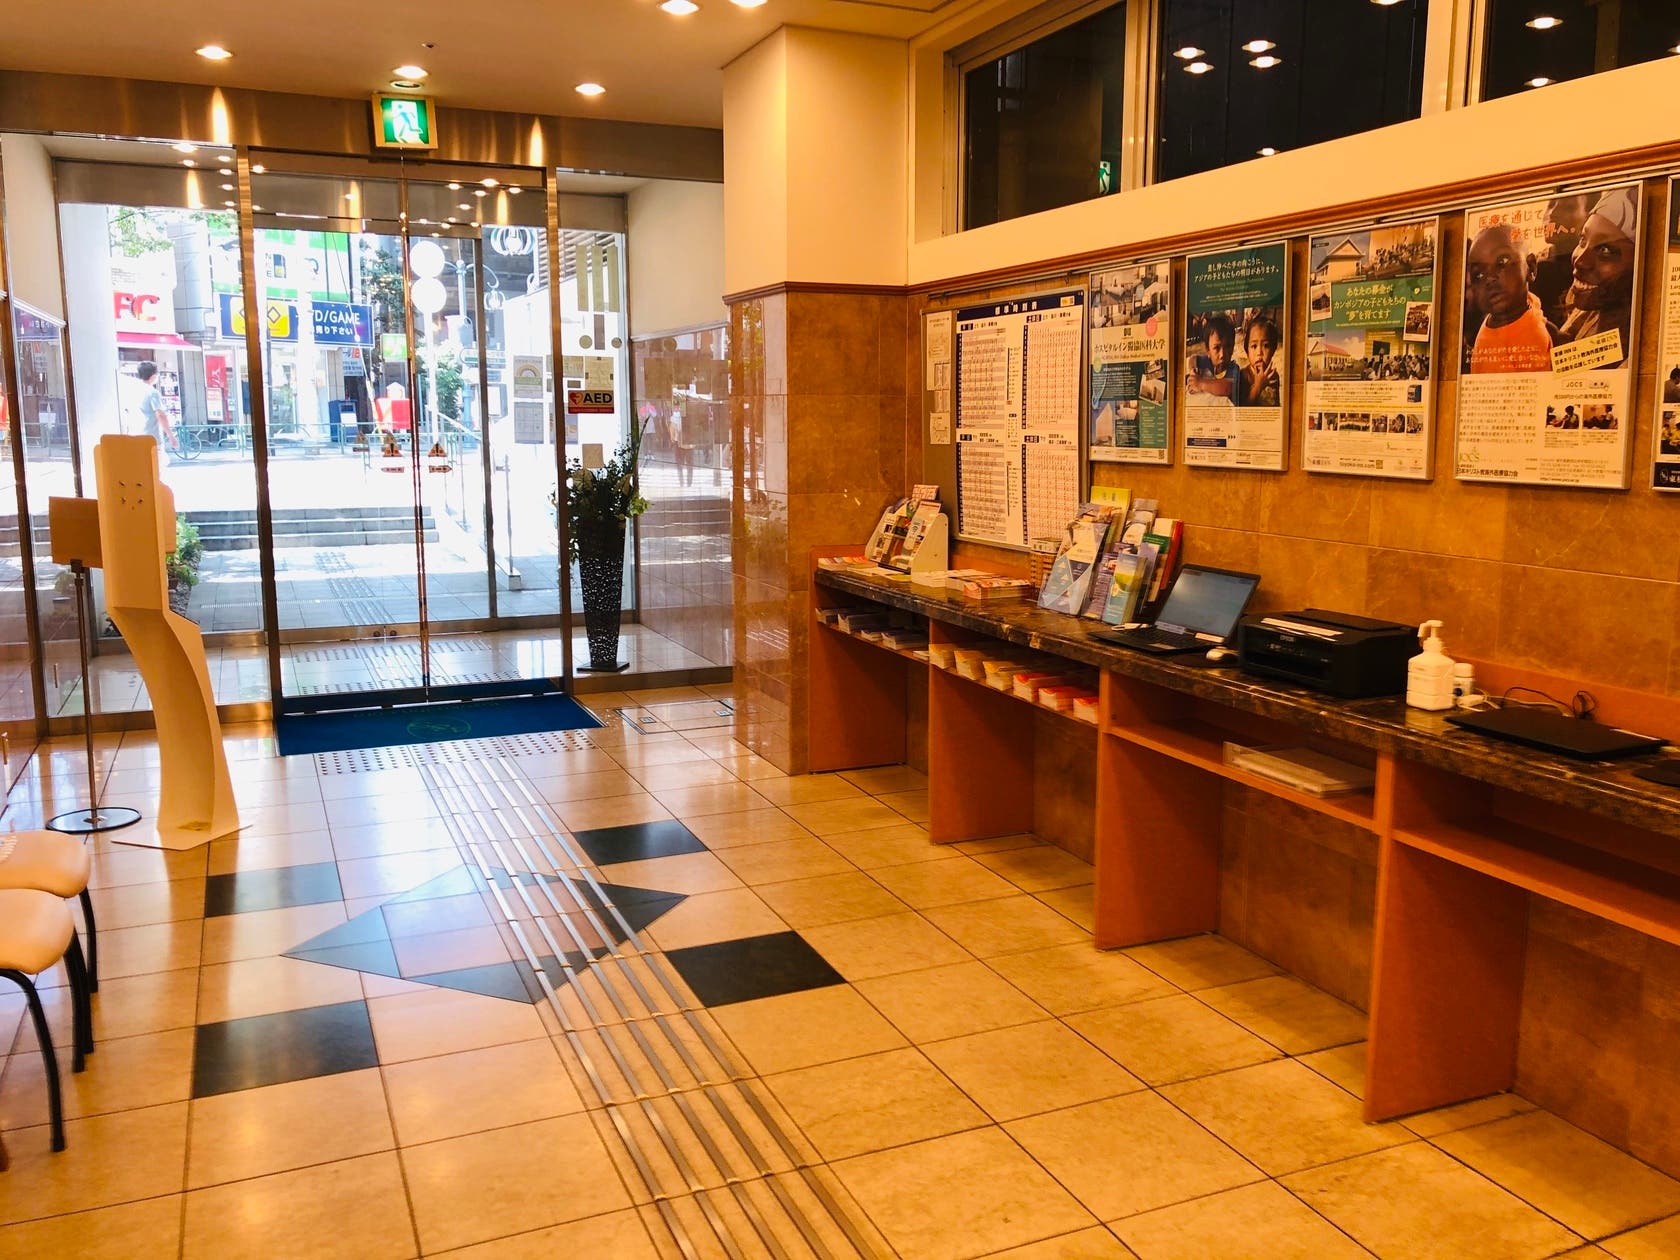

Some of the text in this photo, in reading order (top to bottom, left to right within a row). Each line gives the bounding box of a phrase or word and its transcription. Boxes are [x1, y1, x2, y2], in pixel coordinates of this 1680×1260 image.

[1480, 210, 1544, 228] 医療を通じて
[583, 392, 613, 404] AED
